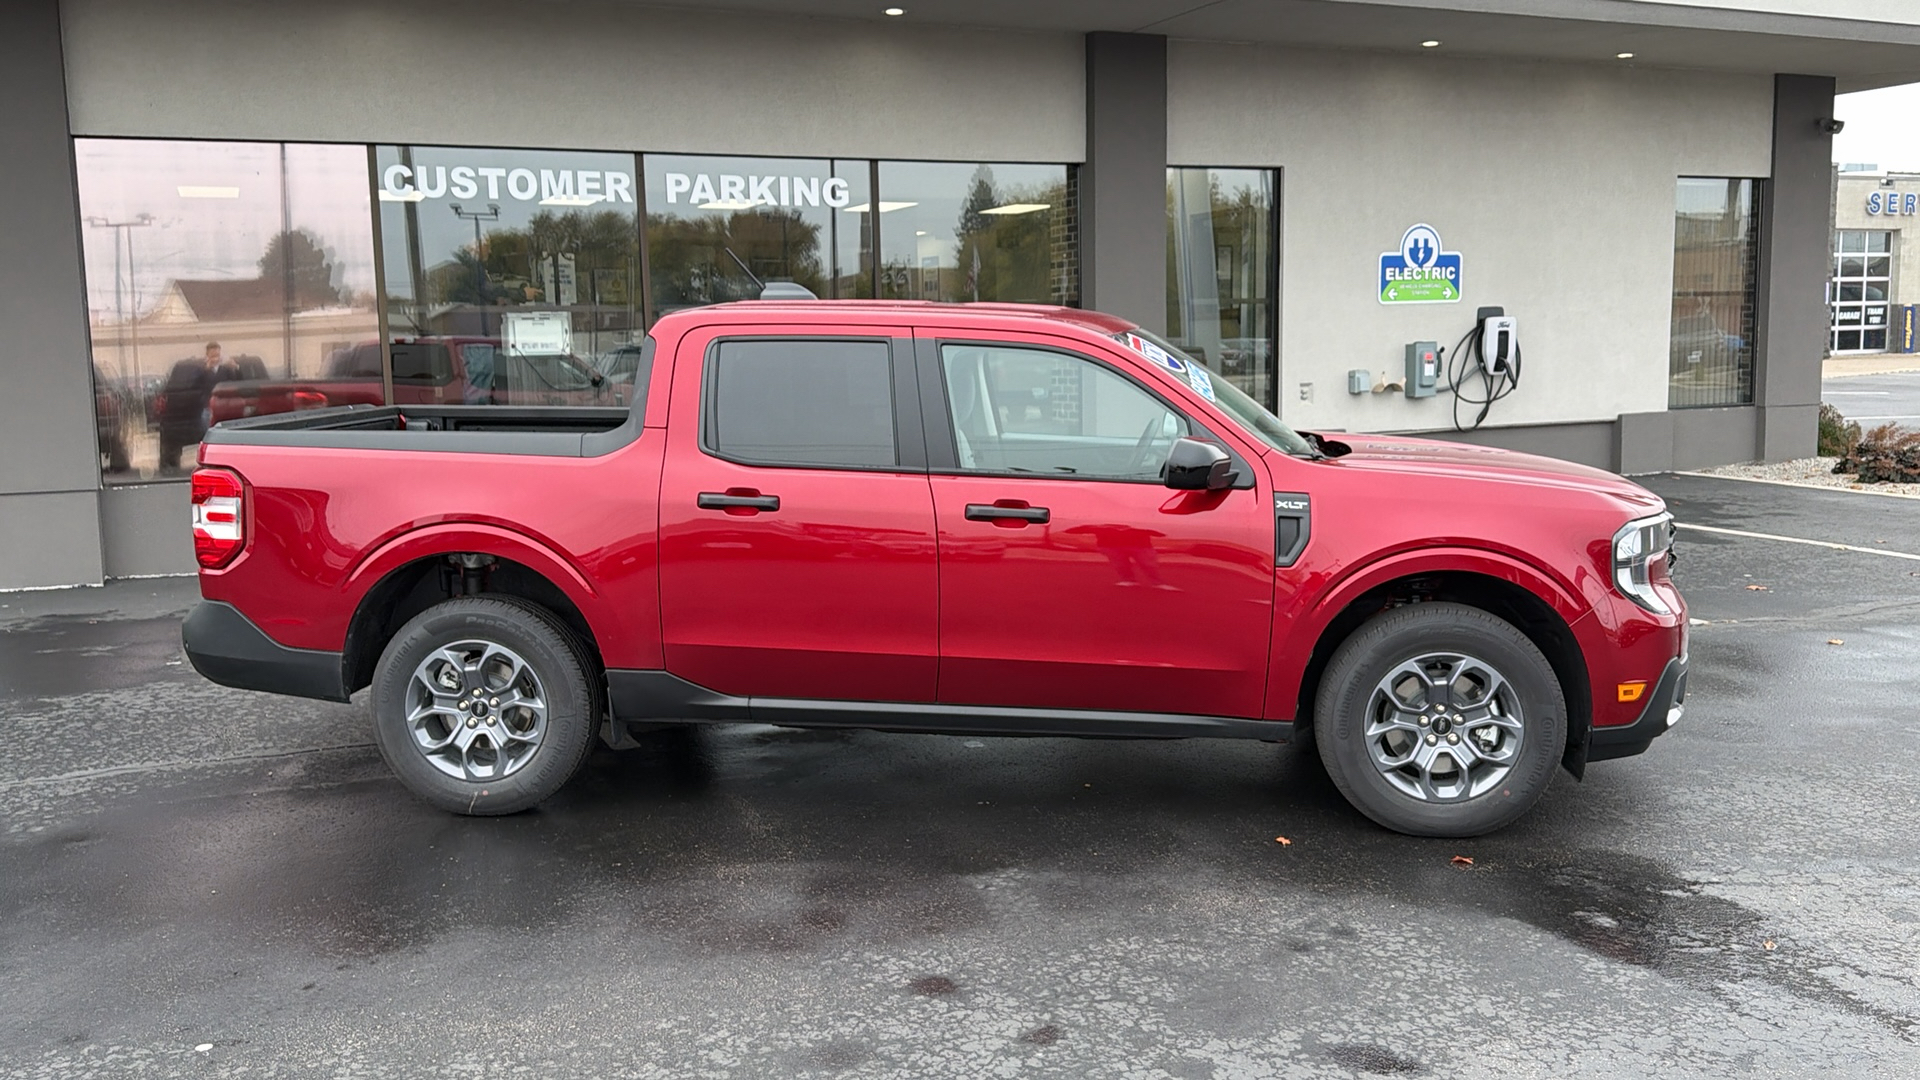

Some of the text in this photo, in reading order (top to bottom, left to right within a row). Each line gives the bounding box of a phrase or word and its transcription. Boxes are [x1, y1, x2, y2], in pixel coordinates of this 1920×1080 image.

[384, 164, 850, 208] CUSTOMER PARKING
[1385, 266, 1456, 281] ELECTRIC
[1276, 500, 1308, 509] XLT
